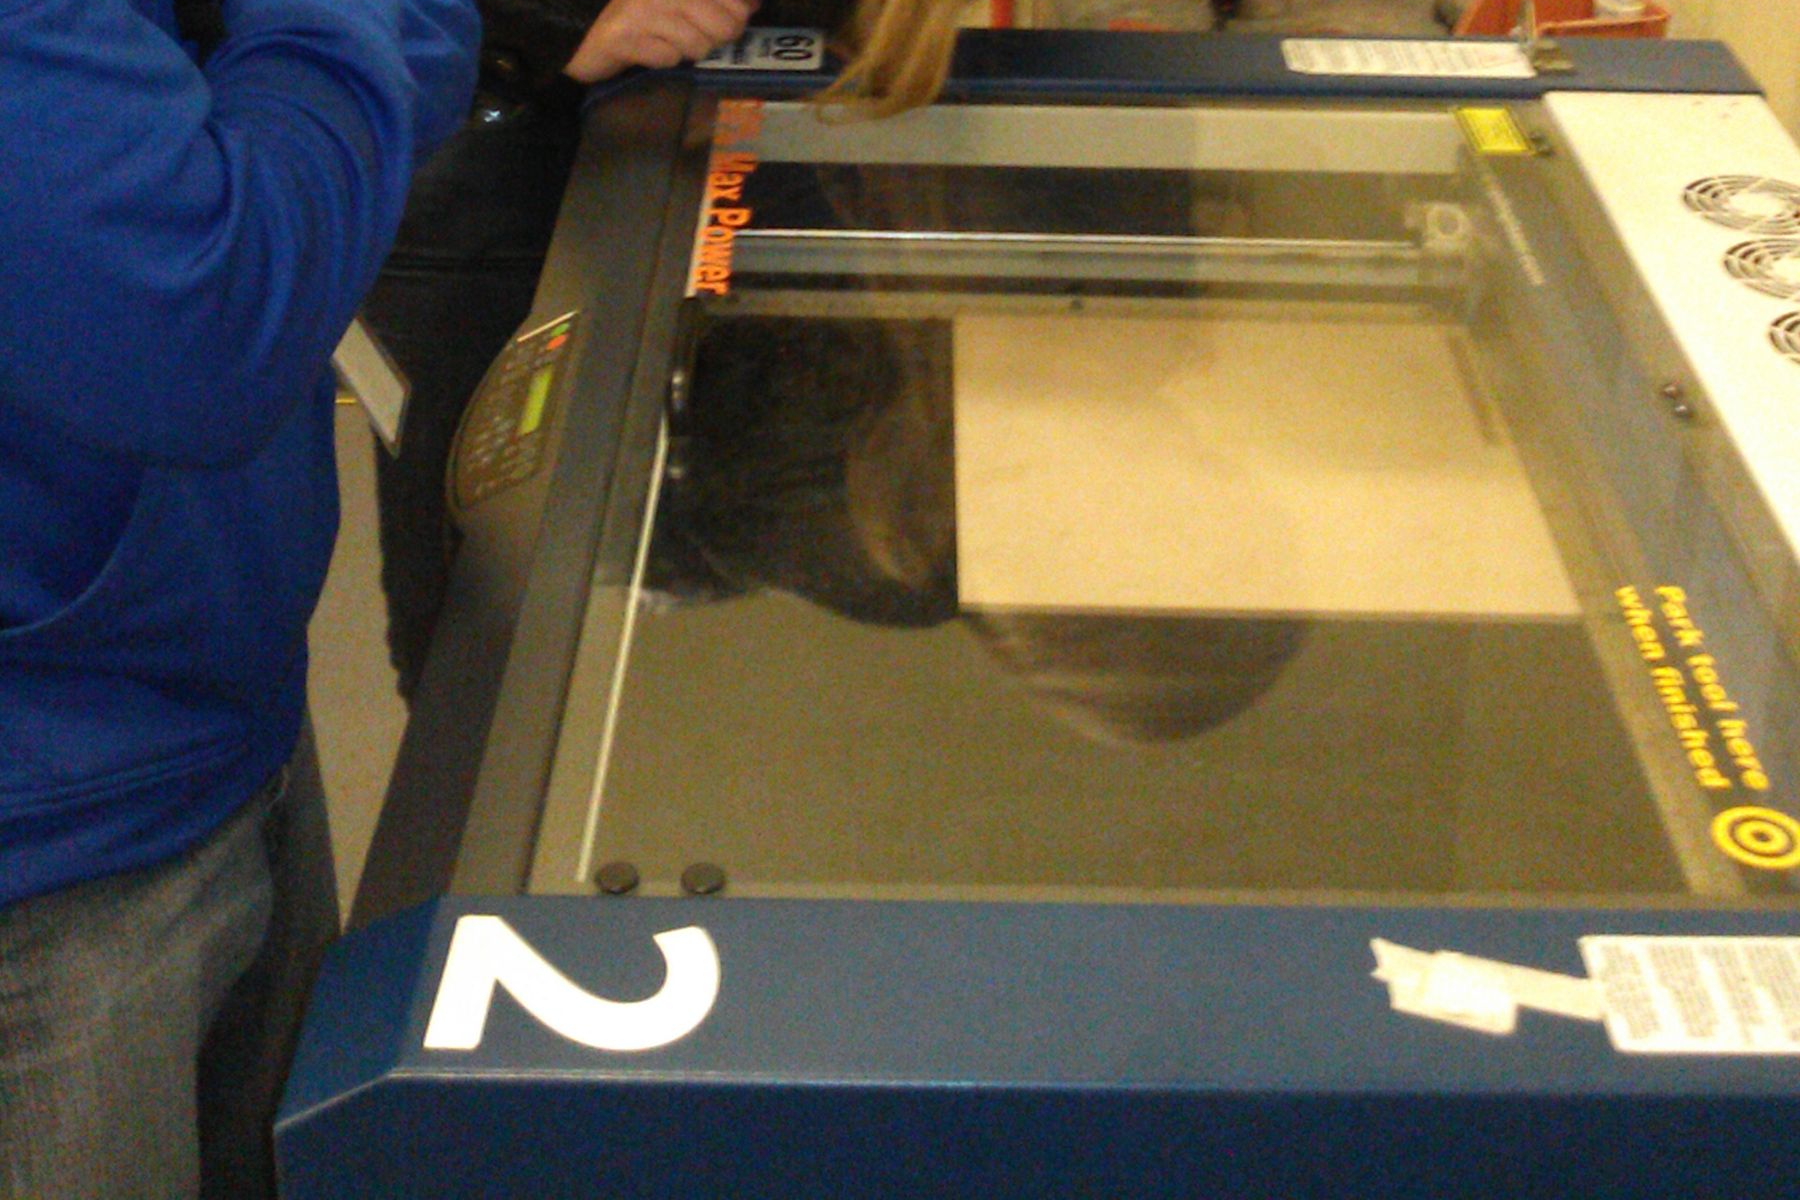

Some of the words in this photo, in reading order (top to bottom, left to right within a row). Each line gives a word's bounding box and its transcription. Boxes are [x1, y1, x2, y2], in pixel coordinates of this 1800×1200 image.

[772, 35, 815, 61] 60
[707, 152, 758, 202] Max
[692, 206, 752, 297] Power
[1614, 584, 1666, 662] when
[1650, 666, 1733, 790] finished
[1653, 584, 1704, 648] Park
[1686, 653, 1740, 713] tool
[1716, 718, 1770, 791] here
[423, 915, 719, 1052] 2
